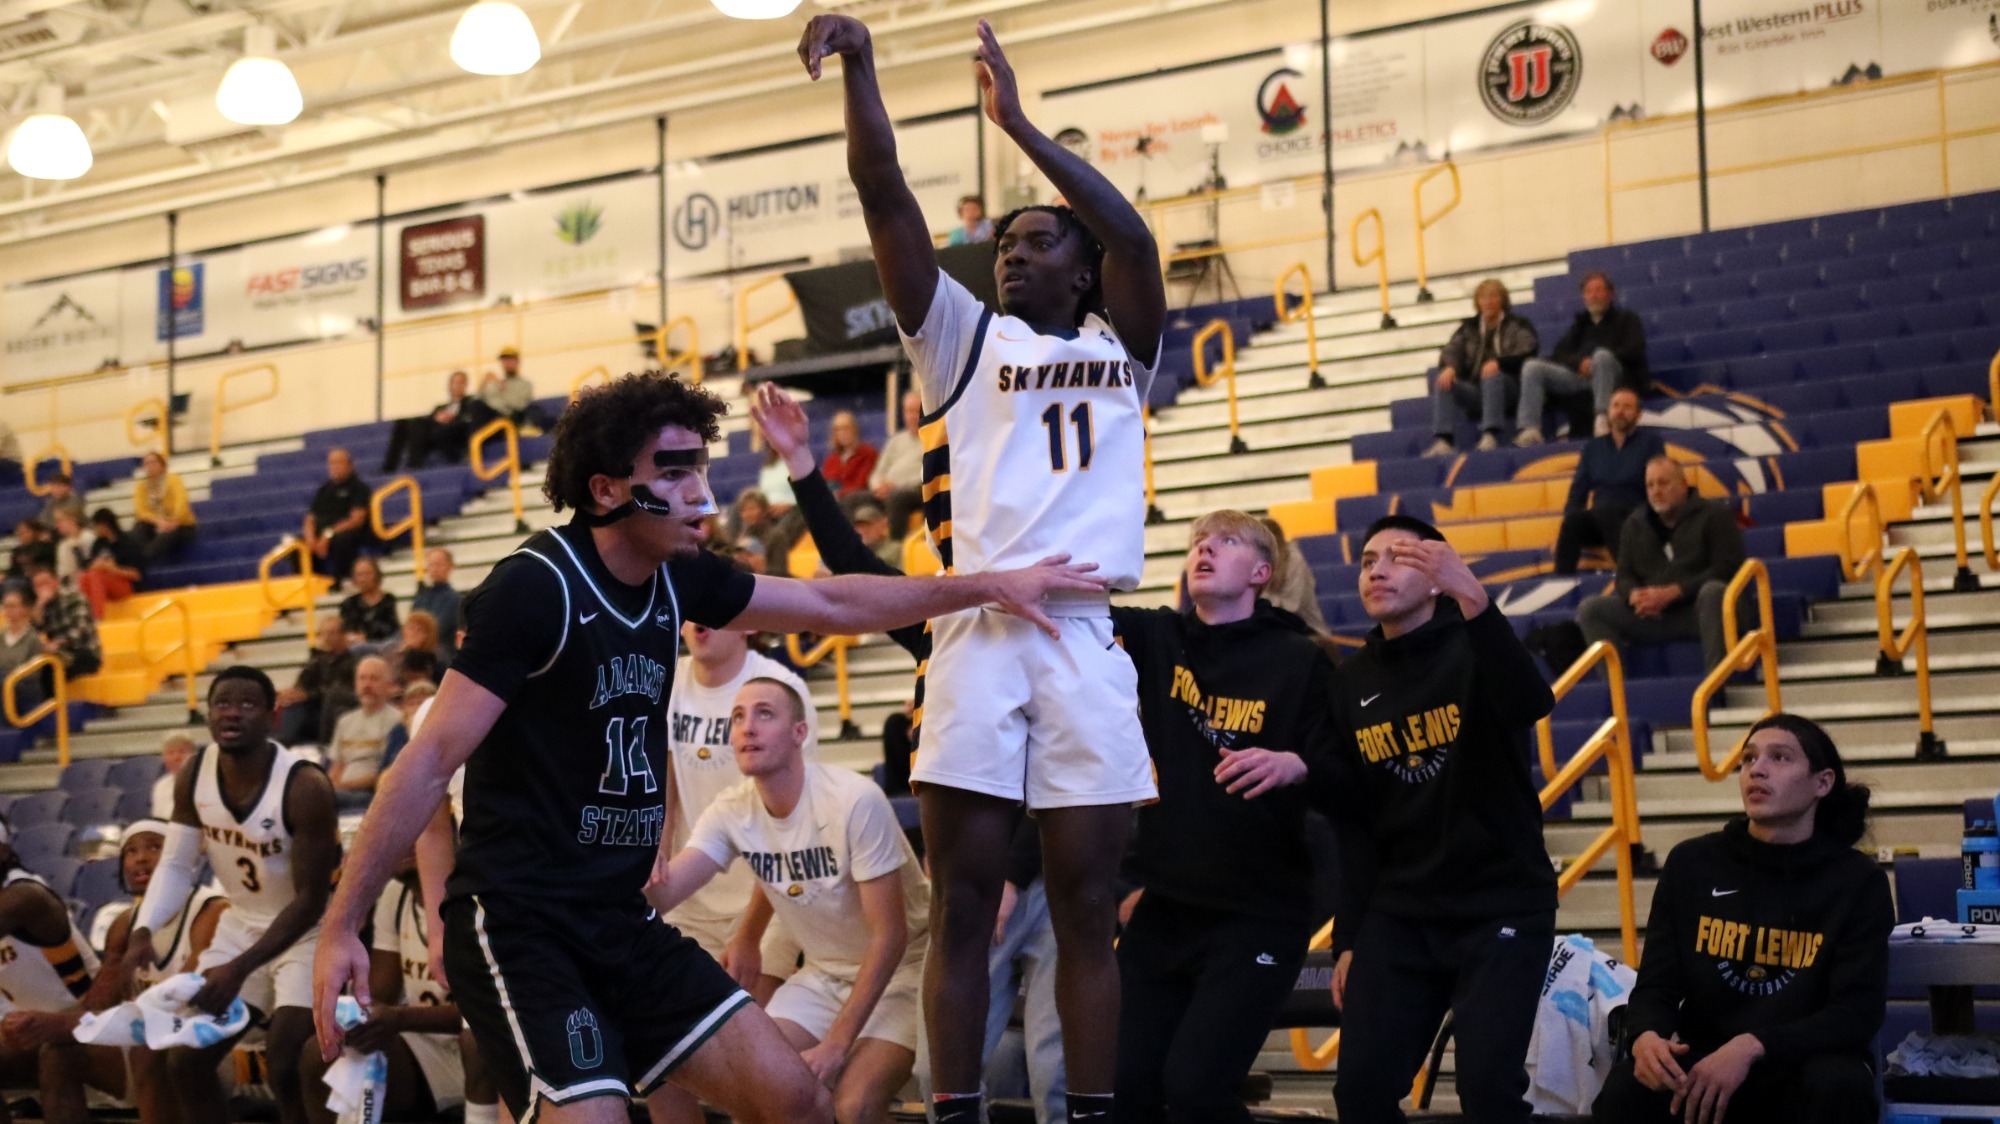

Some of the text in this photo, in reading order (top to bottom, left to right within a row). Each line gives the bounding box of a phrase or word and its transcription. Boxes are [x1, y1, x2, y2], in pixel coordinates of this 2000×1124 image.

[1700, 0, 1863, 42] est Western PLUS
[1509, 48, 1551, 101] JJ
[1258, 135, 1313, 160] CHOICE
[728, 184, 820, 219] HUTTON
[246, 259, 369, 297] FASTSIGNS
[998, 361, 1133, 391] SKYHAWKS
[1041, 401, 1095, 474] 11
[1206, 695, 1267, 734] LEWIS
[1355, 703, 1461, 764] FORT LEWIS
[599, 716, 658, 796] 14
[577, 804, 665, 847] STATE
[236, 857, 261, 893] 3
[783, 846, 839, 881] LEWIS
[1695, 915, 1823, 969] FORT LEWIS
[1717, 961, 1796, 996] BASKETBALL
